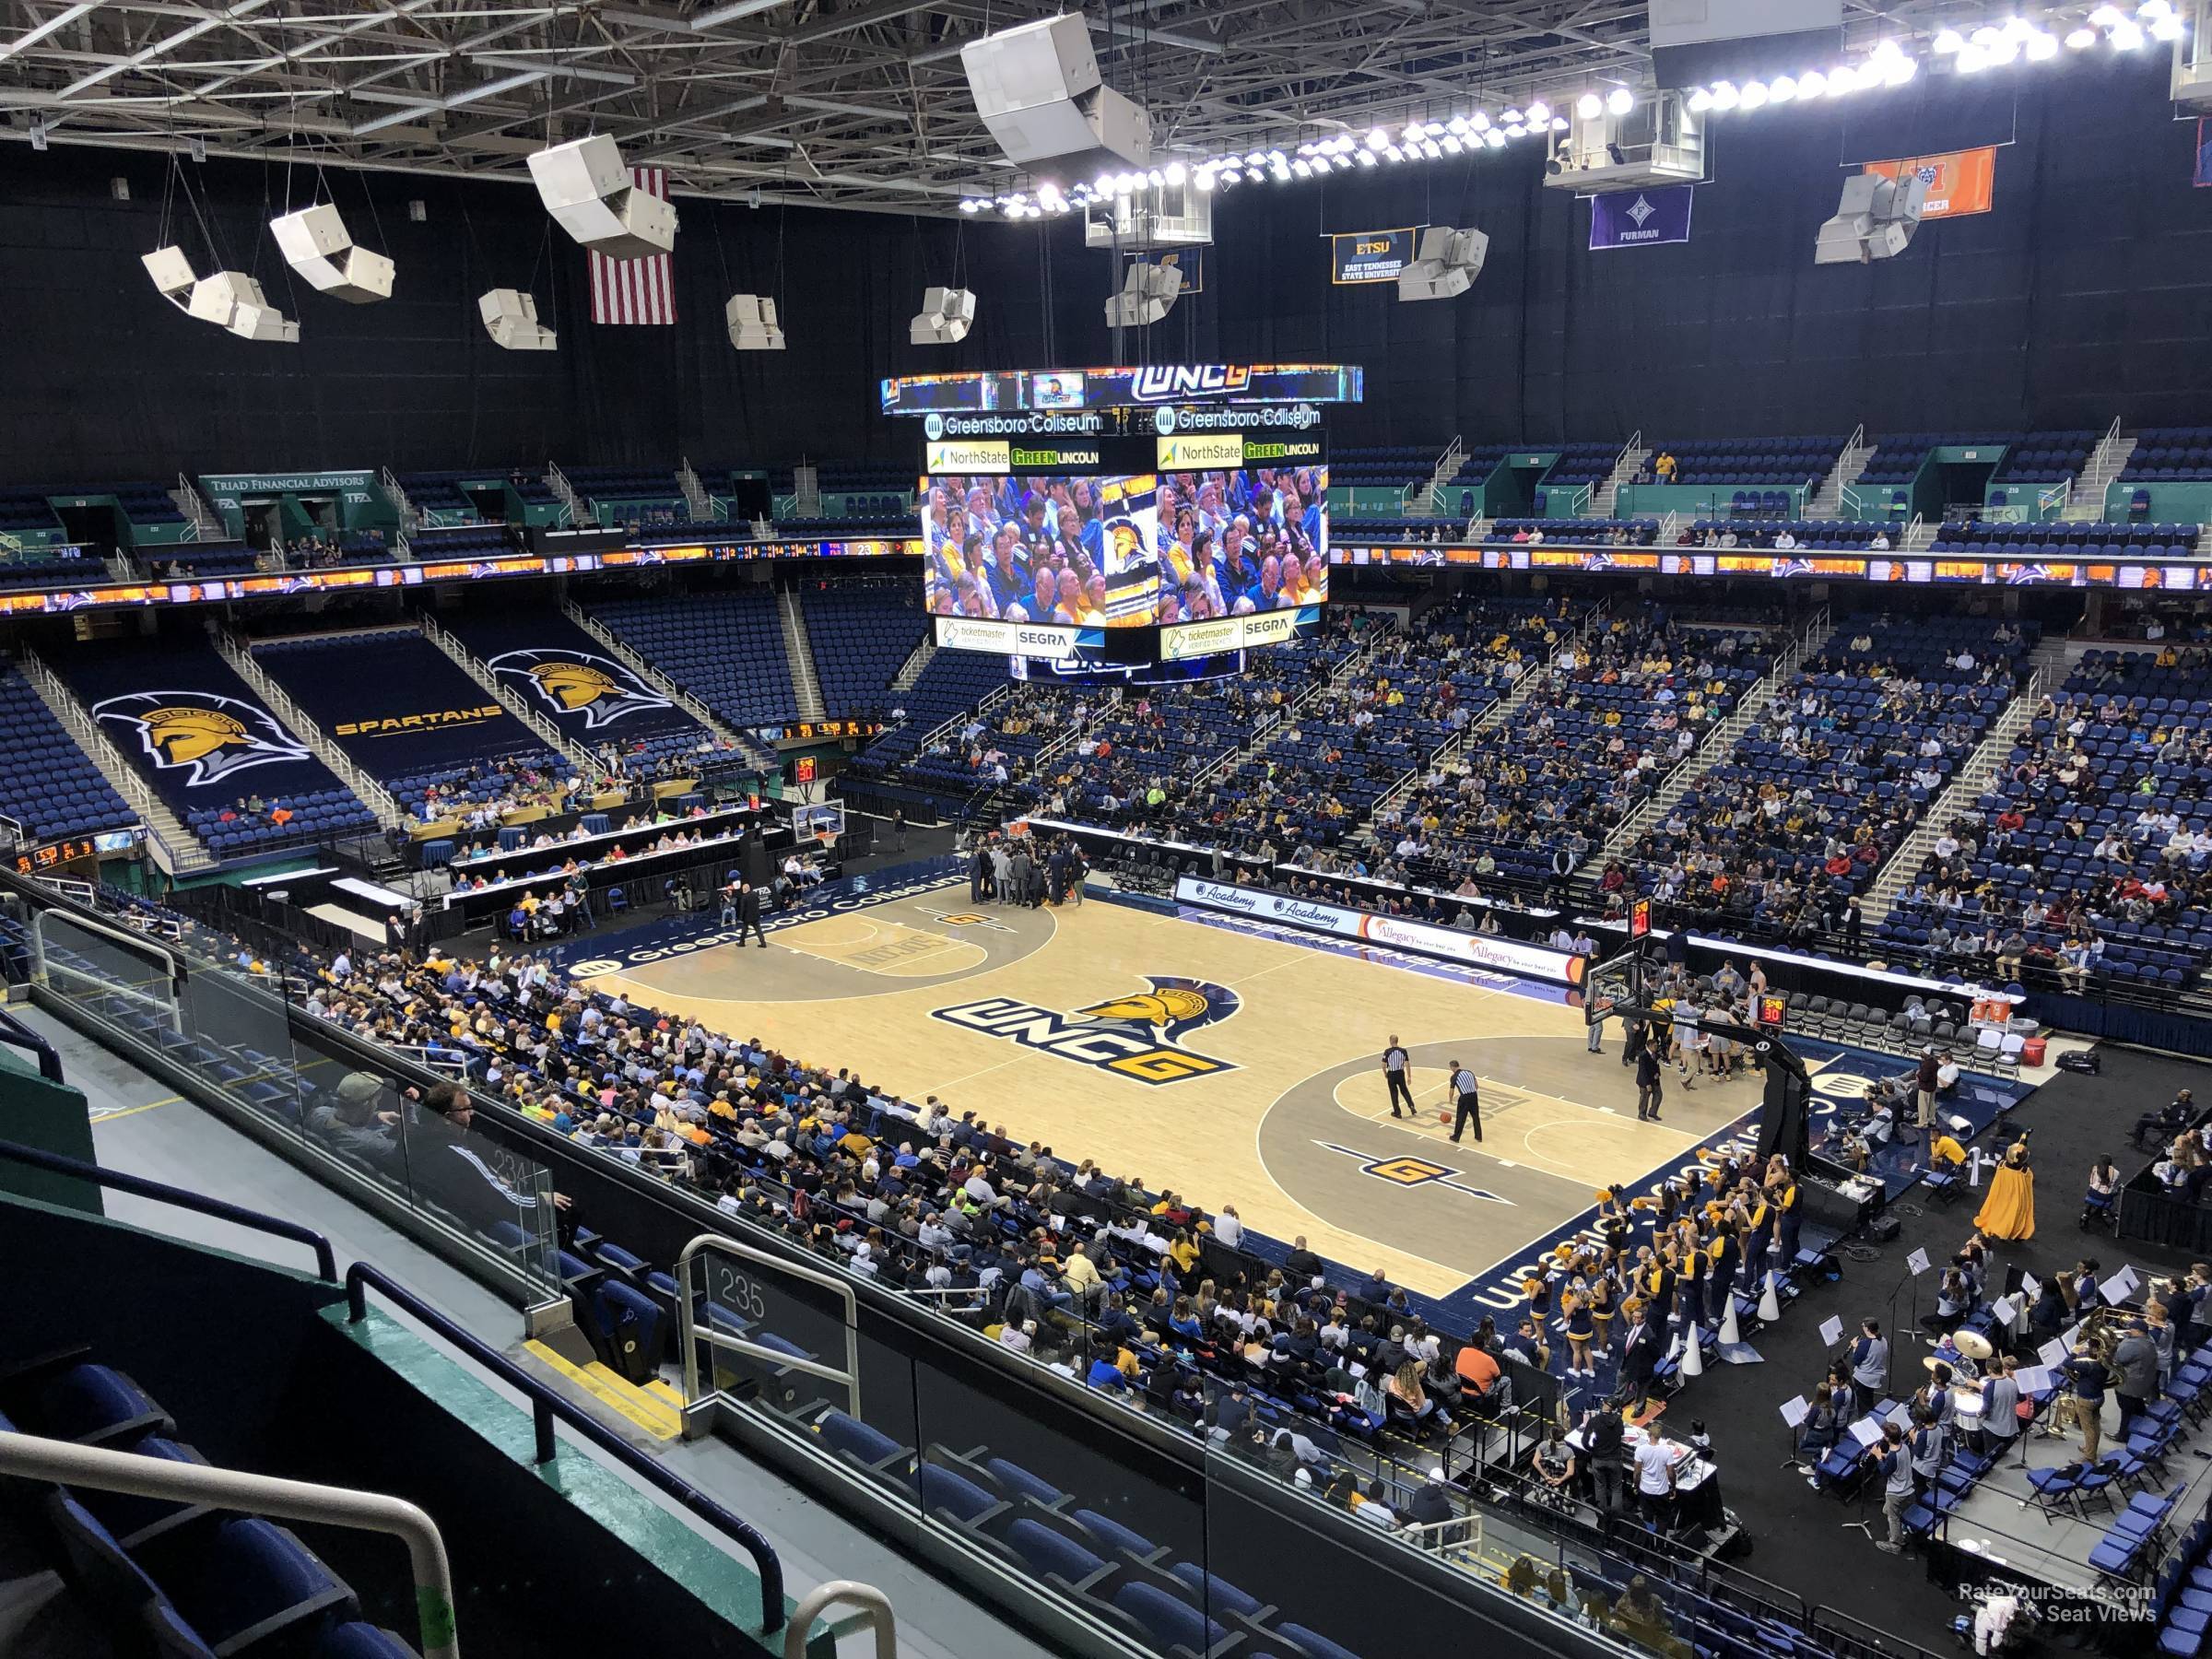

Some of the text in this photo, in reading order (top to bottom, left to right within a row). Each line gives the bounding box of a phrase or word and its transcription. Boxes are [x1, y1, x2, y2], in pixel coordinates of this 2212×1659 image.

[1620, 229, 1660, 241] FURMAN
[1356, 241, 1390, 255] ETSU
[1342, 268, 1402, 280] STATE UNIVERSIT
[1345, 260, 1403, 273] EAST TENNESSEE
[1137, 366, 1250, 398] UNCG
[946, 413, 1100, 435] Greensboro Coliseum
[1178, 408, 1321, 429] Greensboro Coliseum
[949, 450, 1008, 465] NorthState
[1182, 444, 1241, 461] NorthState
[211, 476, 365, 491] TRIAD FINANCIAL ADVISORS
[344, 492, 373, 503] TFA
[857, 544, 873, 555] 23
[960, 626, 1006, 640] ticketmaster
[1187, 626, 1234, 641] ticketmaster
[1245, 618, 1288, 635] SEGRA
[1018, 631, 1068, 646] SEGRA
[335, 705, 503, 735] SPARTANS
[798, 767, 813, 781] 30
[832, 875, 971, 912] Coliseum
[1206, 885, 1256, 911] Academy
[1285, 901, 1340, 929] Academy
[1379, 924, 1418, 946] Allegacy
[1473, 944, 1514, 967] Allegacy
[1766, 998, 1783, 1010] 5:40
[1673, 1015, 1699, 1027] SPALDING
[1764, 1009, 1780, 1021] 30
[933, 999, 1235, 1085] UNCG
[494, 1149, 529, 1189] 234
[721, 1267, 764, 1318] 235
